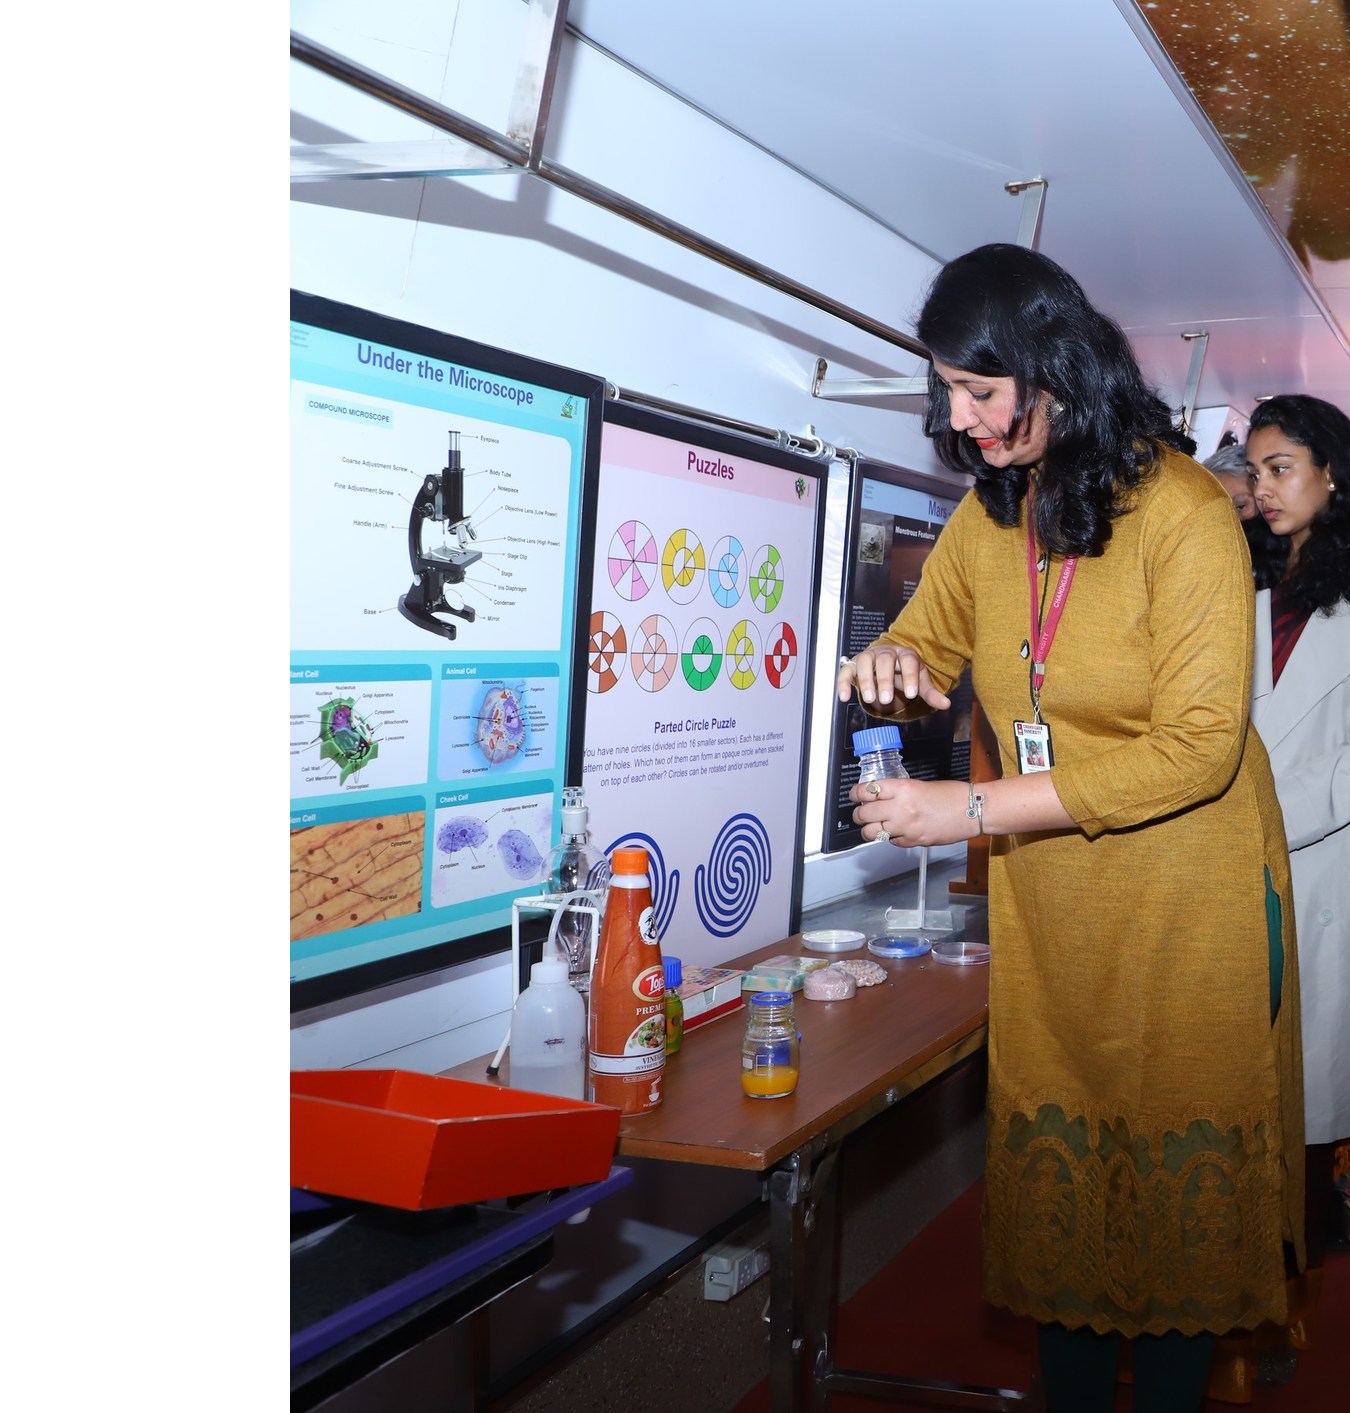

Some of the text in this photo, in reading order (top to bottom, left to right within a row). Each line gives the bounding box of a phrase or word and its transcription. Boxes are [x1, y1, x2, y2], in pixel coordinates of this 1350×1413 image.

[357, 342, 534, 406] Under the Microscope
[308, 400, 391, 423] COMPOUND MICROSCOPE
[341, 456, 408, 473] Coarse Adjustment Screw
[489, 468, 512, 478] Body Tube
[687, 450, 735, 481] Puzzles
[333, 482, 395, 496] Fine Adjustment Screw
[927, 499, 948, 519] Mars
[353, 520, 388, 530] Handle (Arm)
[894, 525, 935, 541] Monstrous Features
[1053, 566, 1073, 608] CHANDIGARH
[290, 669, 319, 679] lant Cell
[446, 667, 477, 675] Animal Cell
[654, 716, 737, 734] Parted Circle Puzzle
[583, 747, 596, 758] You
[597, 747, 614, 756] have
[615, 745, 630, 755] nine
[630, 743, 651, 754] circles
[652, 740, 676, 753] (divided
[676, 740, 688, 749] into
[689, 739, 696, 748] 16
[696, 737, 717, 748] smaller
[739, 733, 752, 744] Each
[752, 734, 762, 742] has
[766, 731, 784, 741] different
[582, 763, 603, 774] attern
[604, 760, 612, 771] of
[633, 757, 654, 768] Which
[654, 757, 666, 766] two
[666, 754, 674, 765] of
[674, 755, 689, 764] them
[689, 755, 701, 763] can
[700, 751, 714, 761] form
[713, 752, 721, 760] an
[721, 750, 740, 761] opaque
[740, 747, 754, 757] circle
[754, 746, 767, 755] when
[767, 743, 785, 754] stacked
[600, 778, 610, 787] on
[610, 777, 622, 787] top
[622, 774, 630, 785] of
[630, 773, 647, 784] each
[647, 770, 668, 782] other?
[668, 769, 689, 779] Circles
[688, 768, 700, 777] can
[700, 766, 708, 775] be
[708, 763, 727, 774] rotated
[439, 793, 469, 804] Cheek Cell
[302, 813, 317, 822] Cell
[645, 973, 665, 992] Tops
